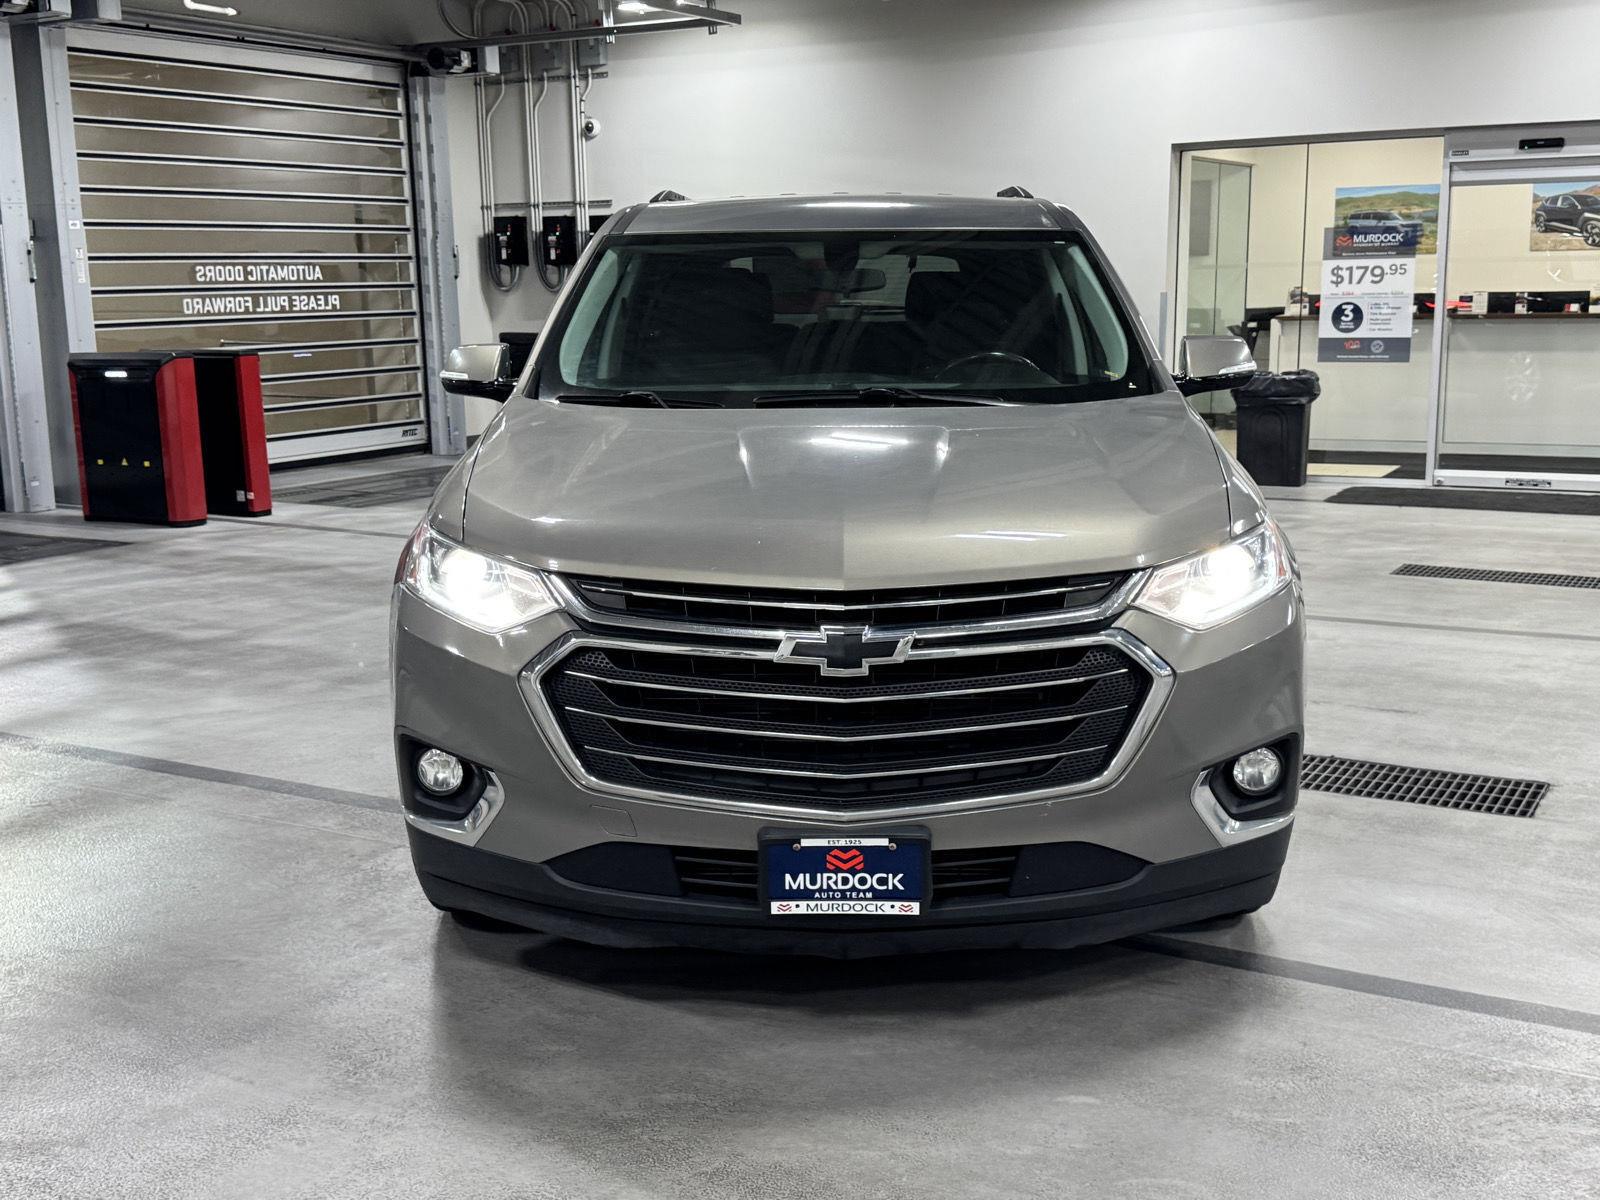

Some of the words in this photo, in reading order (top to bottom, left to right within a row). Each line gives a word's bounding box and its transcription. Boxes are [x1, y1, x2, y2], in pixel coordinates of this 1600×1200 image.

[1353, 233, 1404, 243] MURDOCK
[1330, 263, 1407, 287] $179.95
[1341, 304, 1354, 321] 3
[784, 873, 904, 890] MURDOCK
[806, 903, 885, 912] MURDOCK
